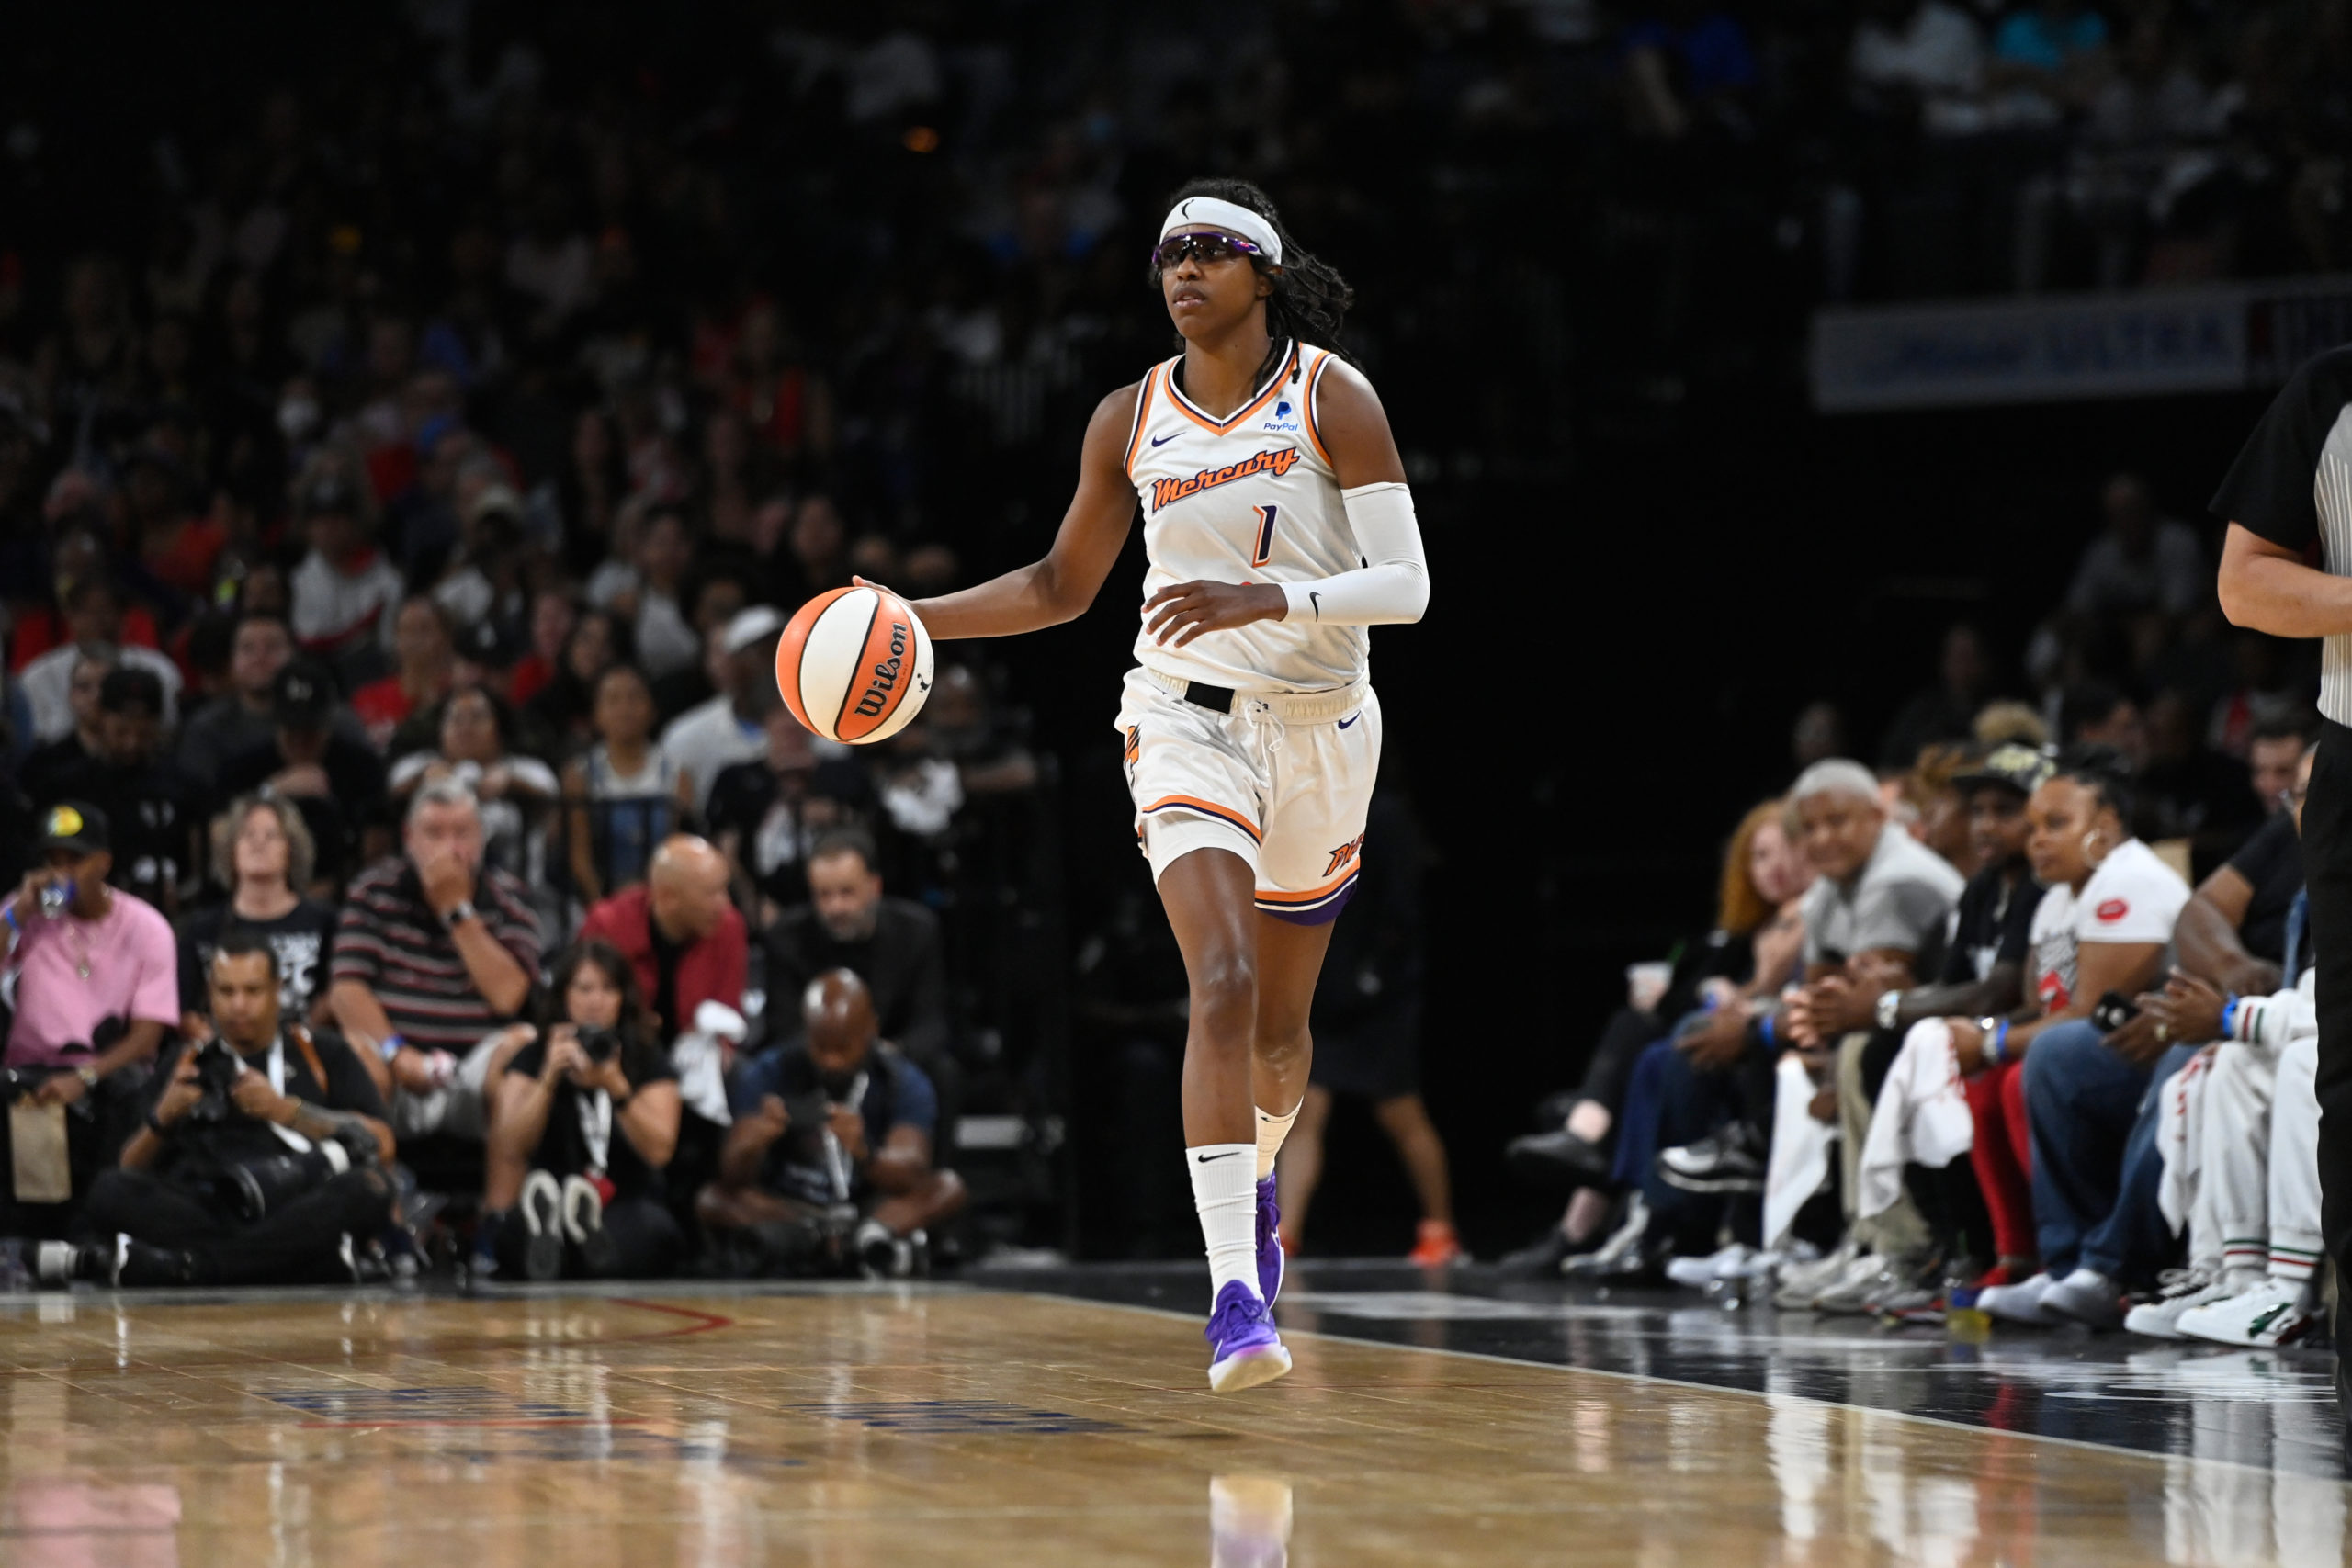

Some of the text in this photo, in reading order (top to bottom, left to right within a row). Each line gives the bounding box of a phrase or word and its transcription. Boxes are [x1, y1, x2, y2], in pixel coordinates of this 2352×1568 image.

[1263, 422, 1299, 432] PayPal
[1151, 446, 1301, 514] Mercury
[1251, 504, 1278, 569] 1
[854, 622, 908, 718] Wilson
